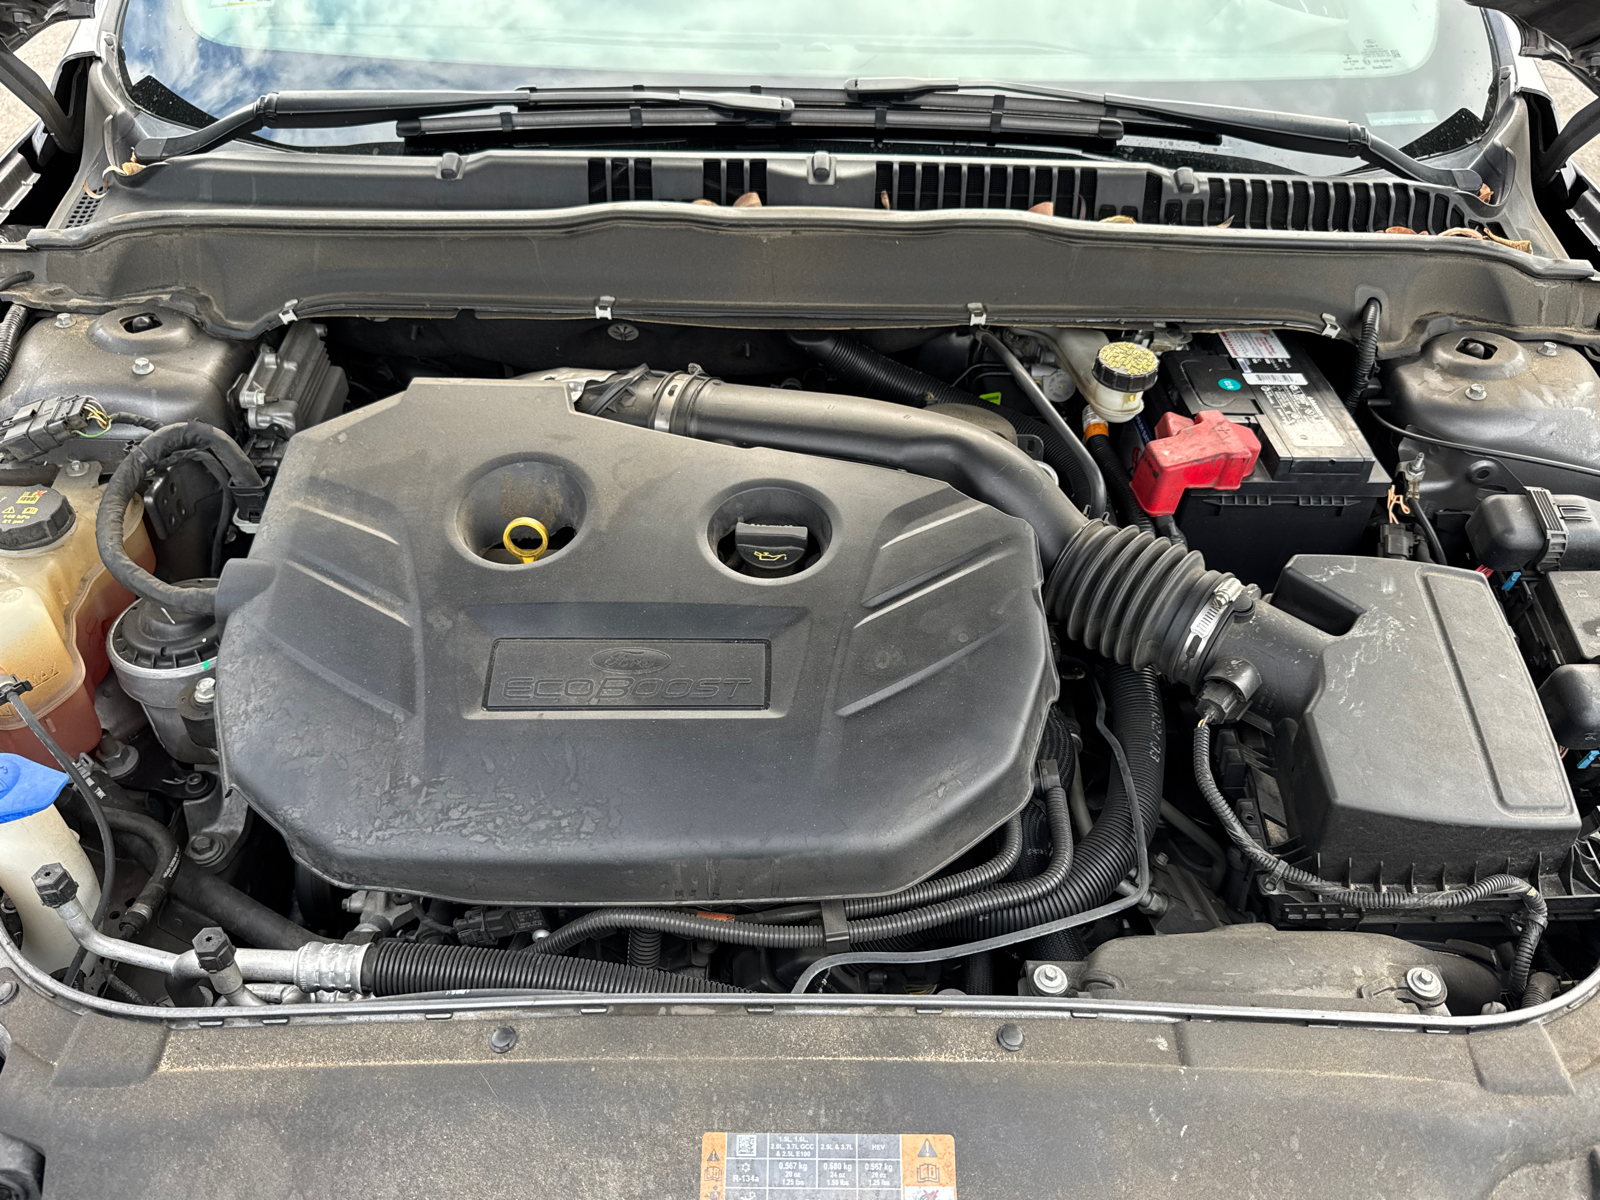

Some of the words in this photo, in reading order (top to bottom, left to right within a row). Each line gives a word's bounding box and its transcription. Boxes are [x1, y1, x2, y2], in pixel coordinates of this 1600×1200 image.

[778, 1161, 798, 1170] 0.567
[798, 1161, 808, 1172] kg
[823, 1162, 842, 1170] 0.680
[843, 1162, 852, 1172] kg
[883, 1163, 893, 1173] kg
[732, 1174, 760, 1183] R-134a
